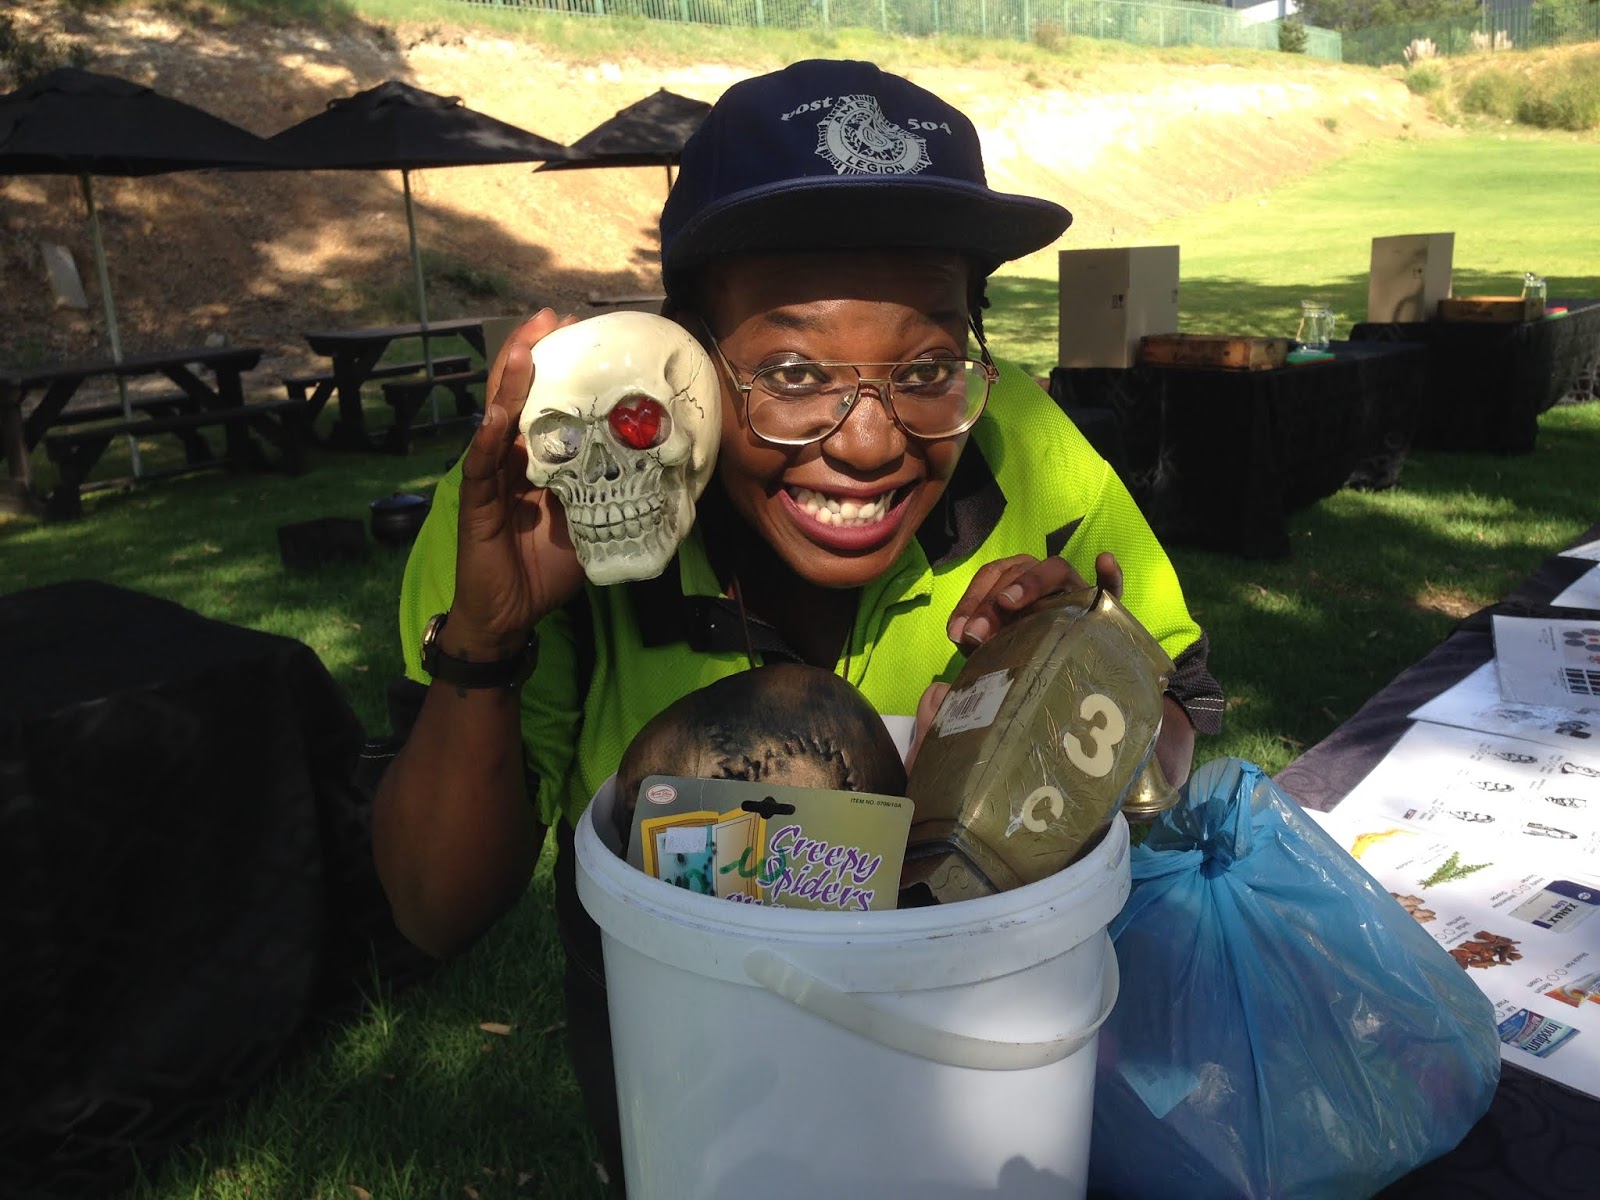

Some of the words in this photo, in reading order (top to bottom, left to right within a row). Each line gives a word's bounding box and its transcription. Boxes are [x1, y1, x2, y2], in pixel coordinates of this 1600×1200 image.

[845, 155, 905, 174] LEGION
[770, 824, 882, 884] Creepy
[756, 855, 876, 911] Spiders
[1547, 902, 1579, 924] XANAX
[1526, 1022, 1563, 1052] Imodium
